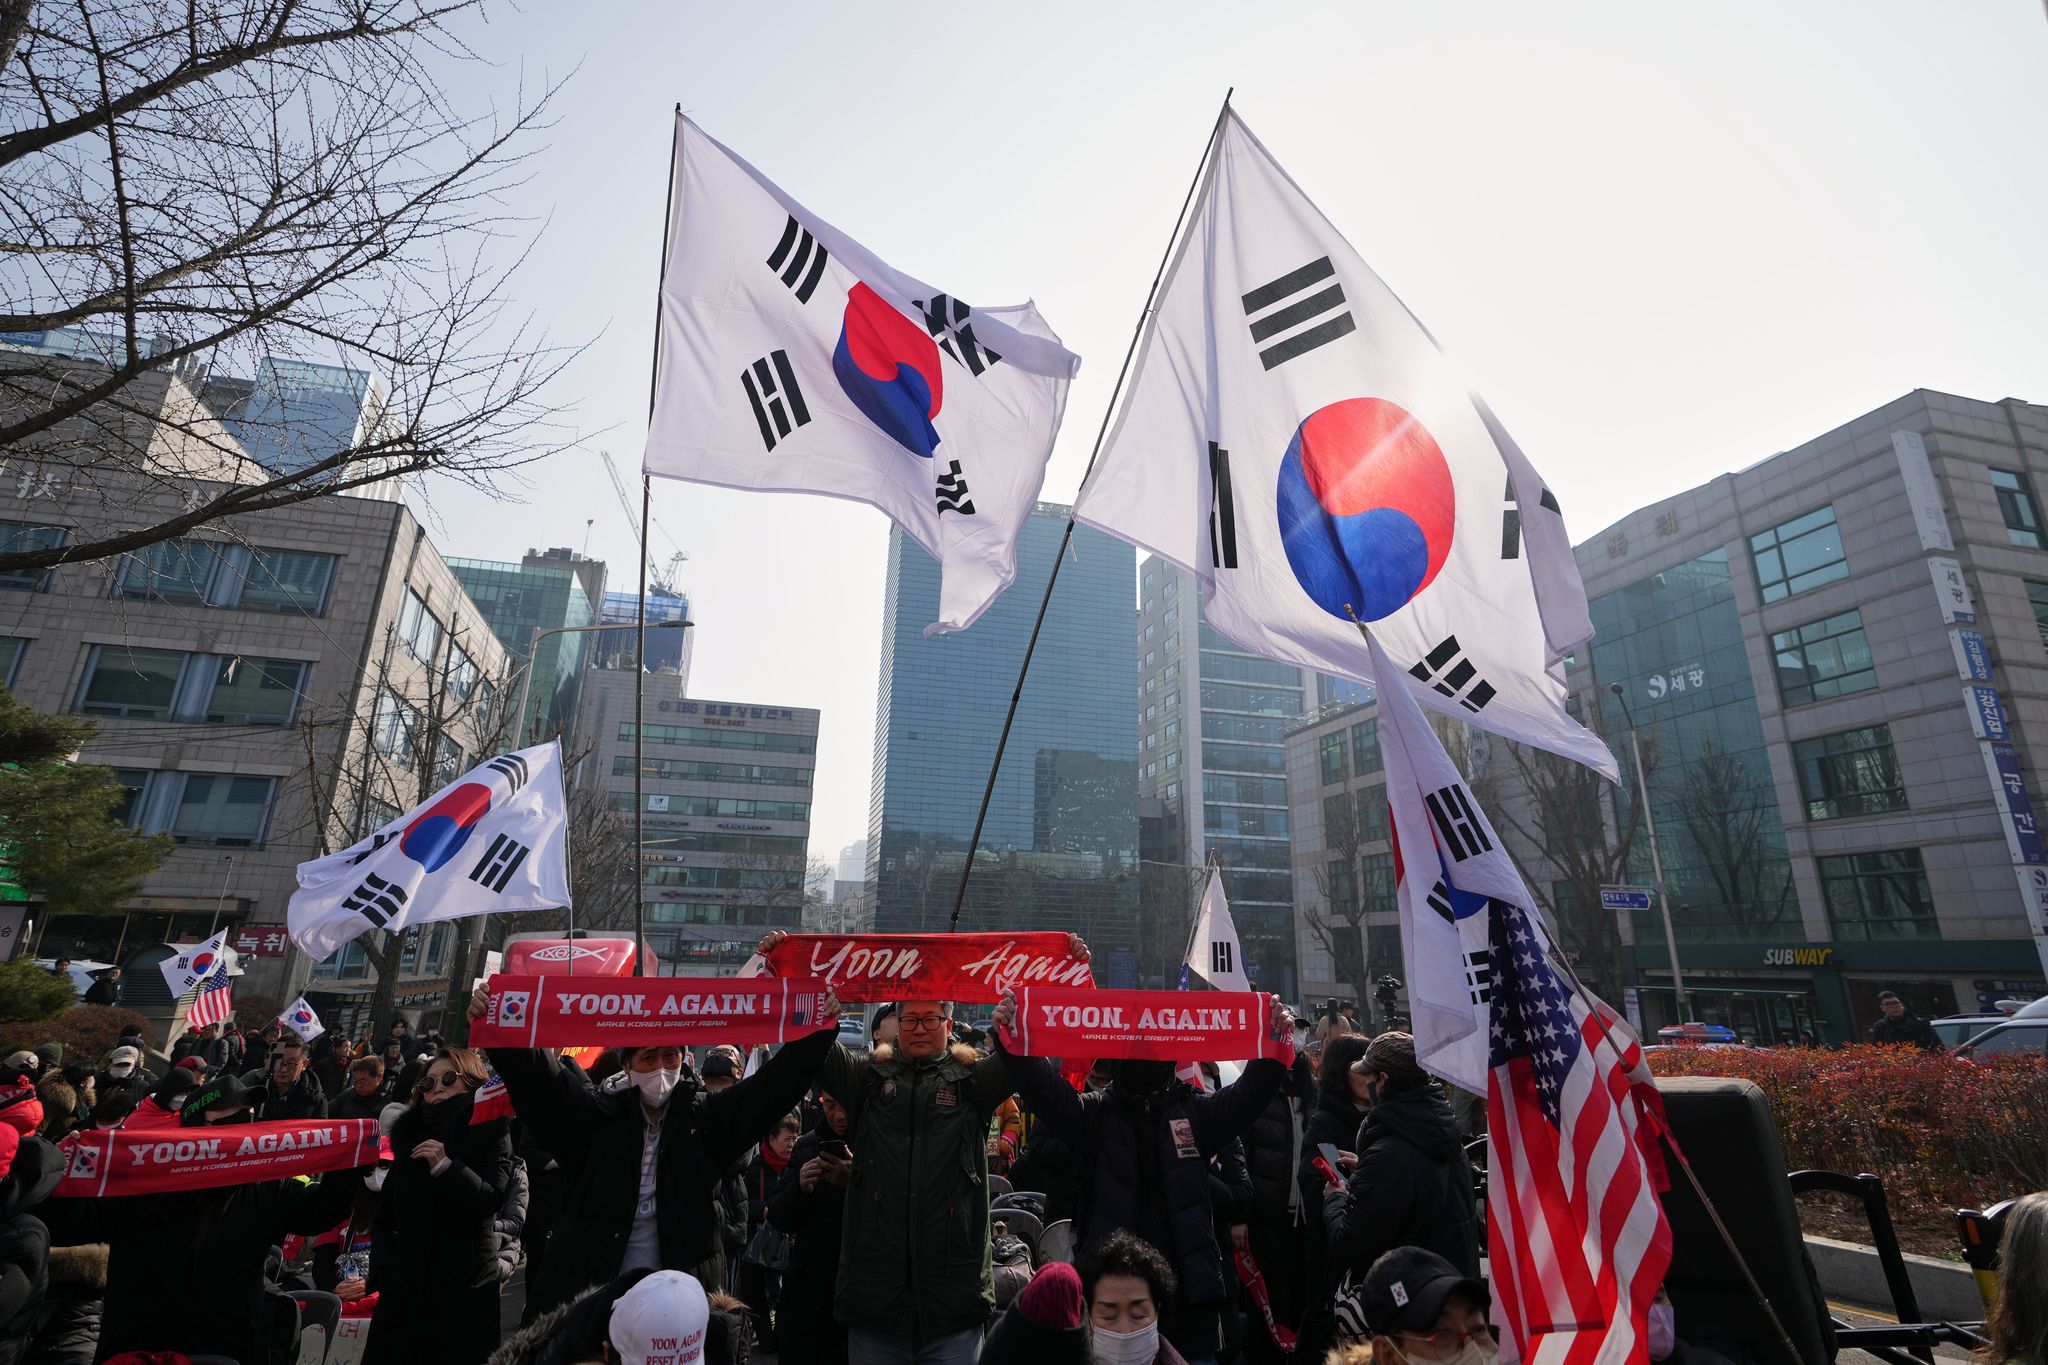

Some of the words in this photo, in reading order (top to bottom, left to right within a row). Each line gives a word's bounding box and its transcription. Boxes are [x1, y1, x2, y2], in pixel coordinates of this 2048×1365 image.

[236, 931, 286, 952] 녹취
[1763, 947, 1833, 965] SUBWAY
[810, 940, 923, 986] Yoon
[961, 940, 1093, 995] Again
[556, 993, 651, 1019] YOON,
[596, 1020, 628, 1028] MAKE
[631, 1020, 663, 1028] KOREA
[664, 1020, 697, 1028] GREAT
[698, 1019, 728, 1028] AGAIN
[1041, 1005, 1130, 1031] YOON,
[1081, 1033, 1108, 1041] MAKE
[1109, 1034, 1142, 1042] KOREA
[1176, 1035, 1206, 1043] AGAIN
[128, 1138, 228, 1166] YOON,
[169, 1165, 199, 1174] MAKE
[199, 1161, 238, 1172] KOREA
[239, 1157, 274, 1168] GREAT
[275, 1153, 305, 1164] AGAIN
[651, 1337, 678, 1351] YOON
